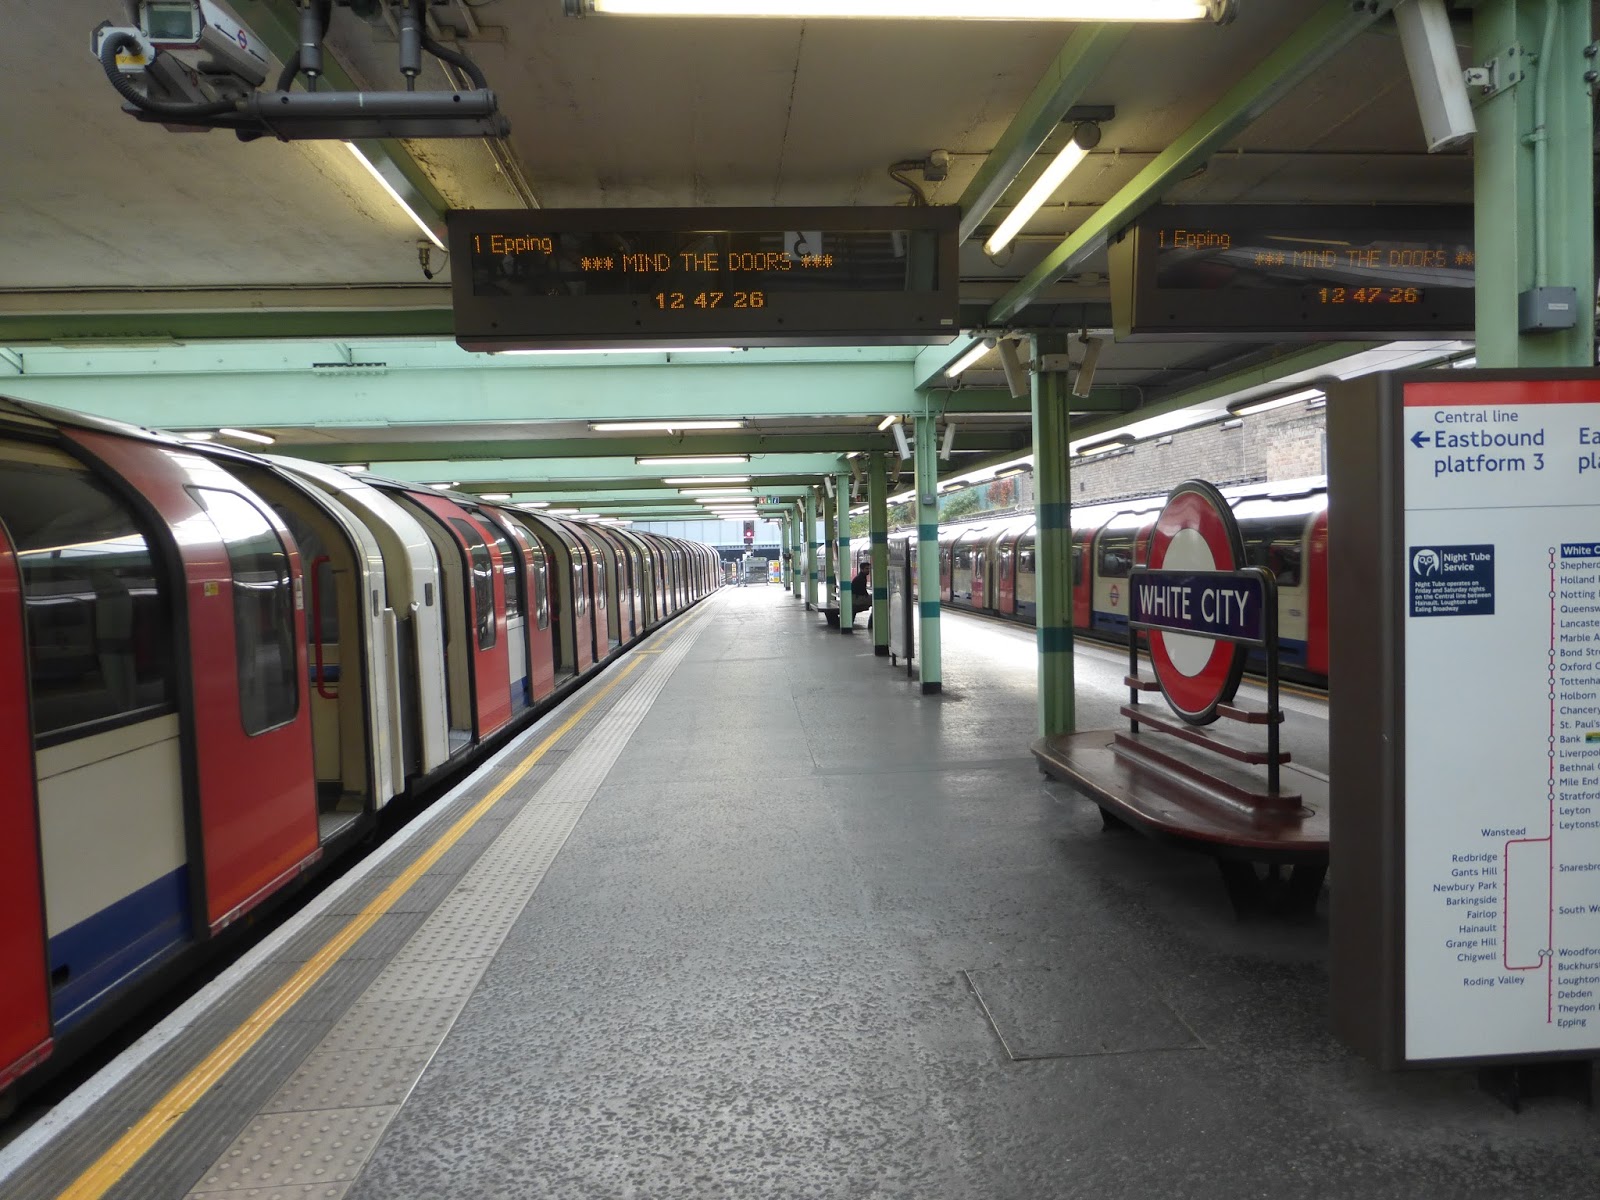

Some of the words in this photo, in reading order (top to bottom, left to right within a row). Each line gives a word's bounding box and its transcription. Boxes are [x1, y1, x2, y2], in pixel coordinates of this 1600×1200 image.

[475, 235, 480, 253] 1
[491, 234, 552, 254] Epping
[1159, 230, 1164, 248] 1
[1174, 230, 1230, 250] Epping
[623, 254, 670, 272] MIND
[680, 253, 719, 271] THE
[728, 252, 792, 271] DOORS
[1293, 250, 1337, 268] MIND
[1346, 250, 1381, 268] THE
[1390, 250, 1447, 268] DOORS
[1319, 287, 1345, 303] 12
[1354, 287, 1382, 303] 47
[1389, 287, 1417, 303] 26
[656, 292, 684, 309] 12
[694, 292, 723, 309] 47
[733, 292, 764, 308] 26
[1434, 410, 1487, 424] Central
[1493, 410, 1518, 422] line
[1435, 428, 1544, 448] Eastbound
[1435, 454, 1525, 478] platform
[1534, 453, 1544, 471] 3
[1563, 546, 1591, 555] White
[1443, 553, 1467, 563] Night
[1469, 552, 1491, 561] Tube
[1444, 563, 1474, 571] Service
[1560, 575, 1595, 584] Holland
[1560, 590, 1595, 600] Notting
[1139, 584, 1192, 620] WHITE
[1200, 588, 1249, 627] CITY
[1560, 633, 1590, 642] Marble
[1560, 648, 1582, 657] Bond
[1586, 647, 1600, 656] Str
[1560, 662, 1592, 671] Oxford
[1560, 692, 1596, 700] Holborn
[1560, 720, 1571, 729] St.
[1560, 735, 1581, 743] Bank
[1560, 763, 1594, 772] Bethnal
[1560, 778, 1579, 786] Mile
[1582, 776, 1598, 785] End
[1560, 806, 1590, 816] Leyton
[1481, 827, 1526, 836] Wanstead
[1452, 853, 1497, 863] Redbridge
[1451, 868, 1478, 877] Gants
[1482, 867, 1497, 875] Hill
[1433, 883, 1474, 892] Newbury
[1478, 881, 1497, 890] Park
[1446, 896, 1497, 906] Barkingside
[1467, 910, 1497, 919] Fairlop
[1559, 905, 1585, 914] South
[1459, 924, 1497, 933] Hainault
[1446, 939, 1478, 949] Grange
[1481, 938, 1497, 946] Hill
[1457, 952, 1497, 963] Chigwell
[1463, 977, 1495, 987] Roding
[1498, 975, 1525, 985] Valley
[1558, 976, 1600, 986] Loughton
[1558, 989, 1592, 999] Debden
[1558, 1003, 1595, 1013] Theydon
[1558, 1018, 1587, 1028] Epping
